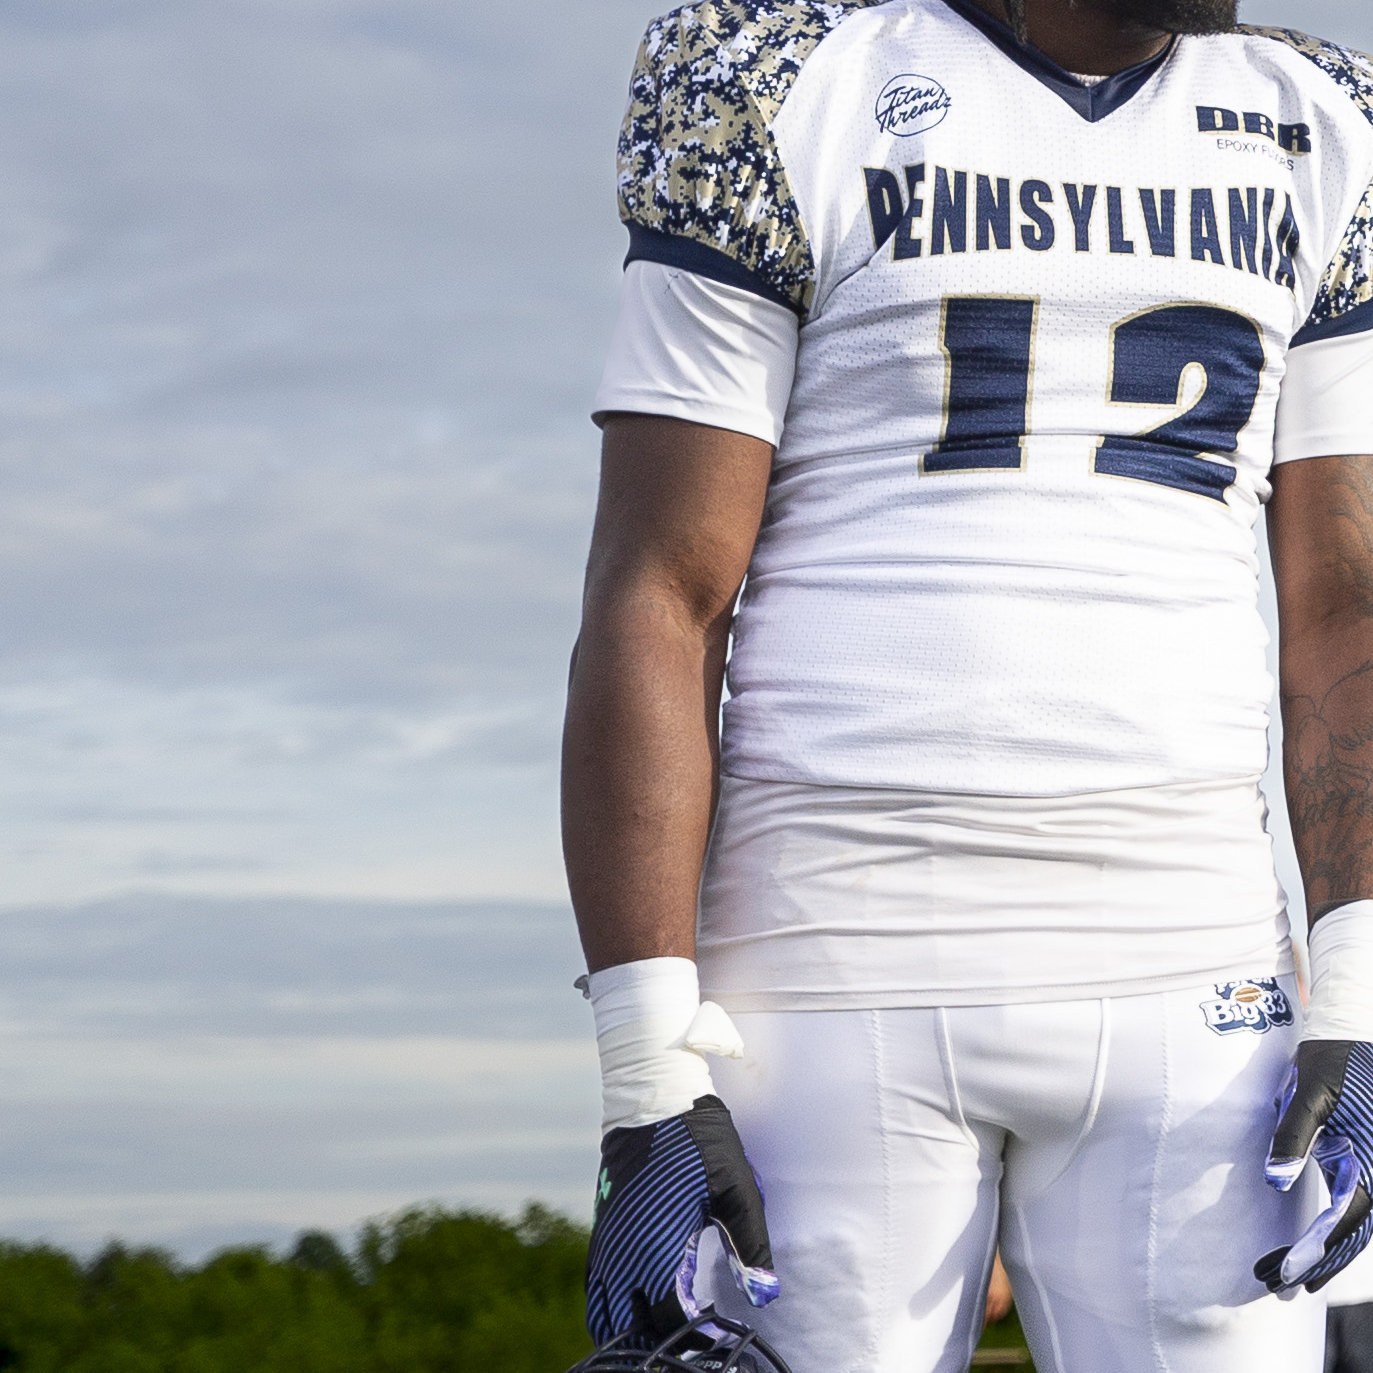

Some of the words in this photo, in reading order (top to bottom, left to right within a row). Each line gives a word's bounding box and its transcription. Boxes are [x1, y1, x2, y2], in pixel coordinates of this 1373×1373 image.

[883, 86, 941, 110] Titan
[1195, 105, 1312, 156] DBR
[1216, 138, 1258, 154] EPOXY
[861, 164, 1302, 291] PENNSYLVANIA
[919, 294, 1267, 507] 12
[1205, 1000, 1261, 1025] Big
[1263, 989, 1287, 1014] 33
